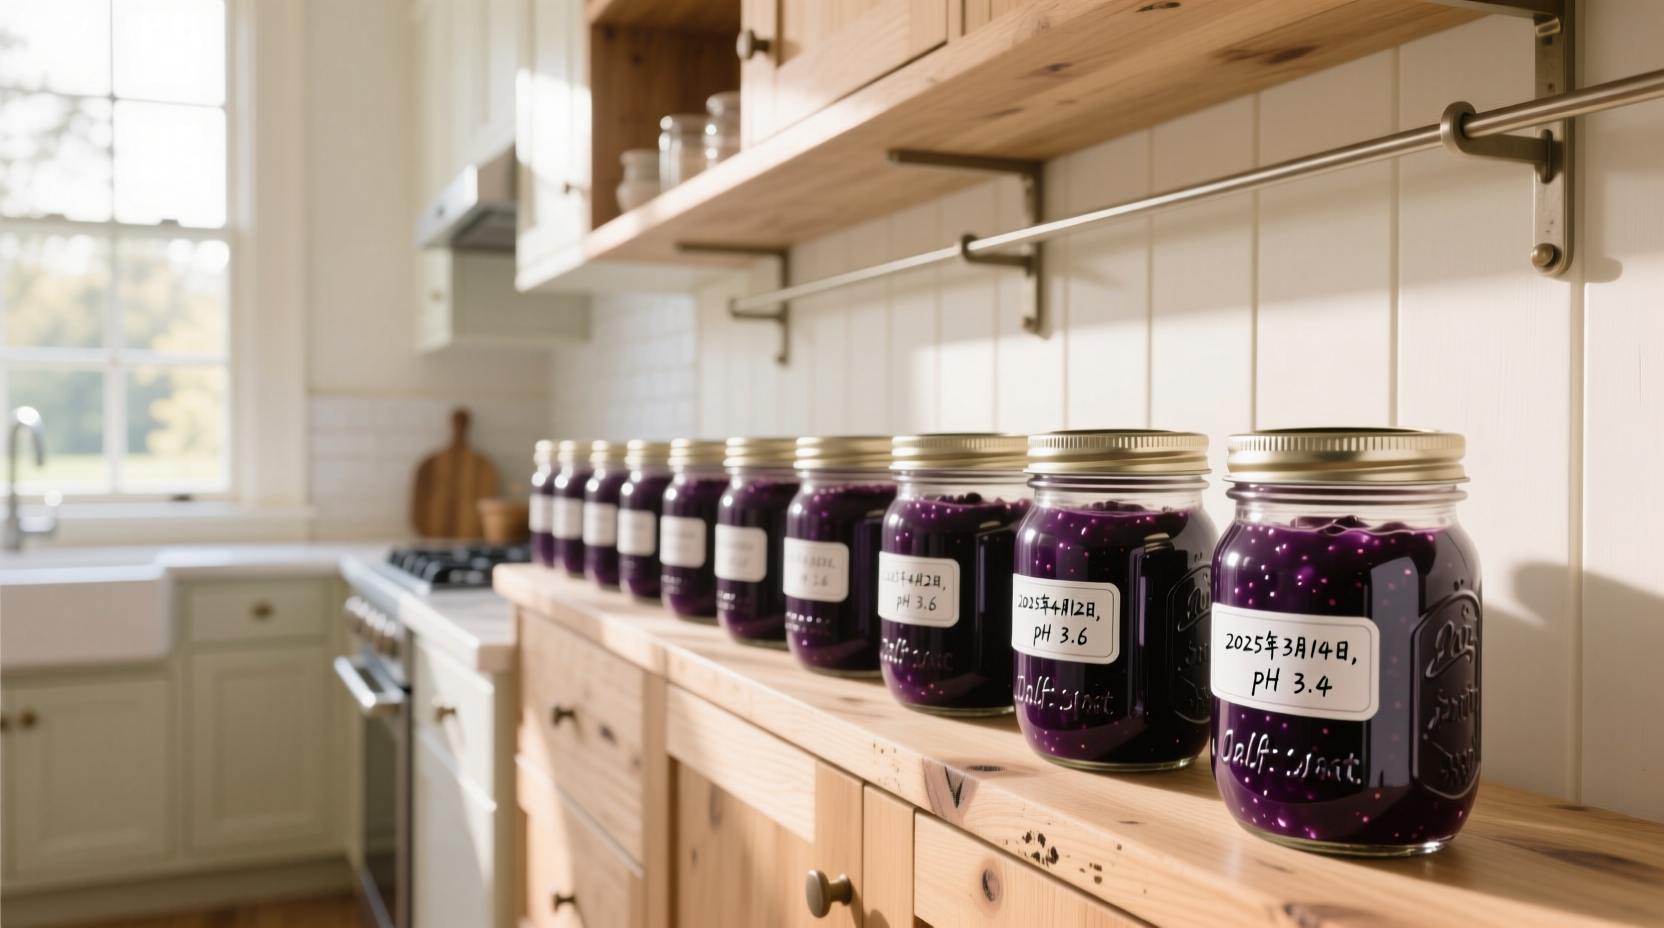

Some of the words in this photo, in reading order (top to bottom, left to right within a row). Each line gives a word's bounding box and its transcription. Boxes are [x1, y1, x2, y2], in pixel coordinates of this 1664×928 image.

[896, 594, 910, 612] pH
[916, 595, 937, 611] 3.6
[1018, 593, 1100, 622] 2025年4月12日,
[1033, 624, 1051, 647] pH
[1060, 627, 1088, 645] 3.6
[1225, 630, 1357, 665] 2025年3月14日,
[1251, 667, 1280, 696] pH
[1294, 672, 1333, 697] 3.4
